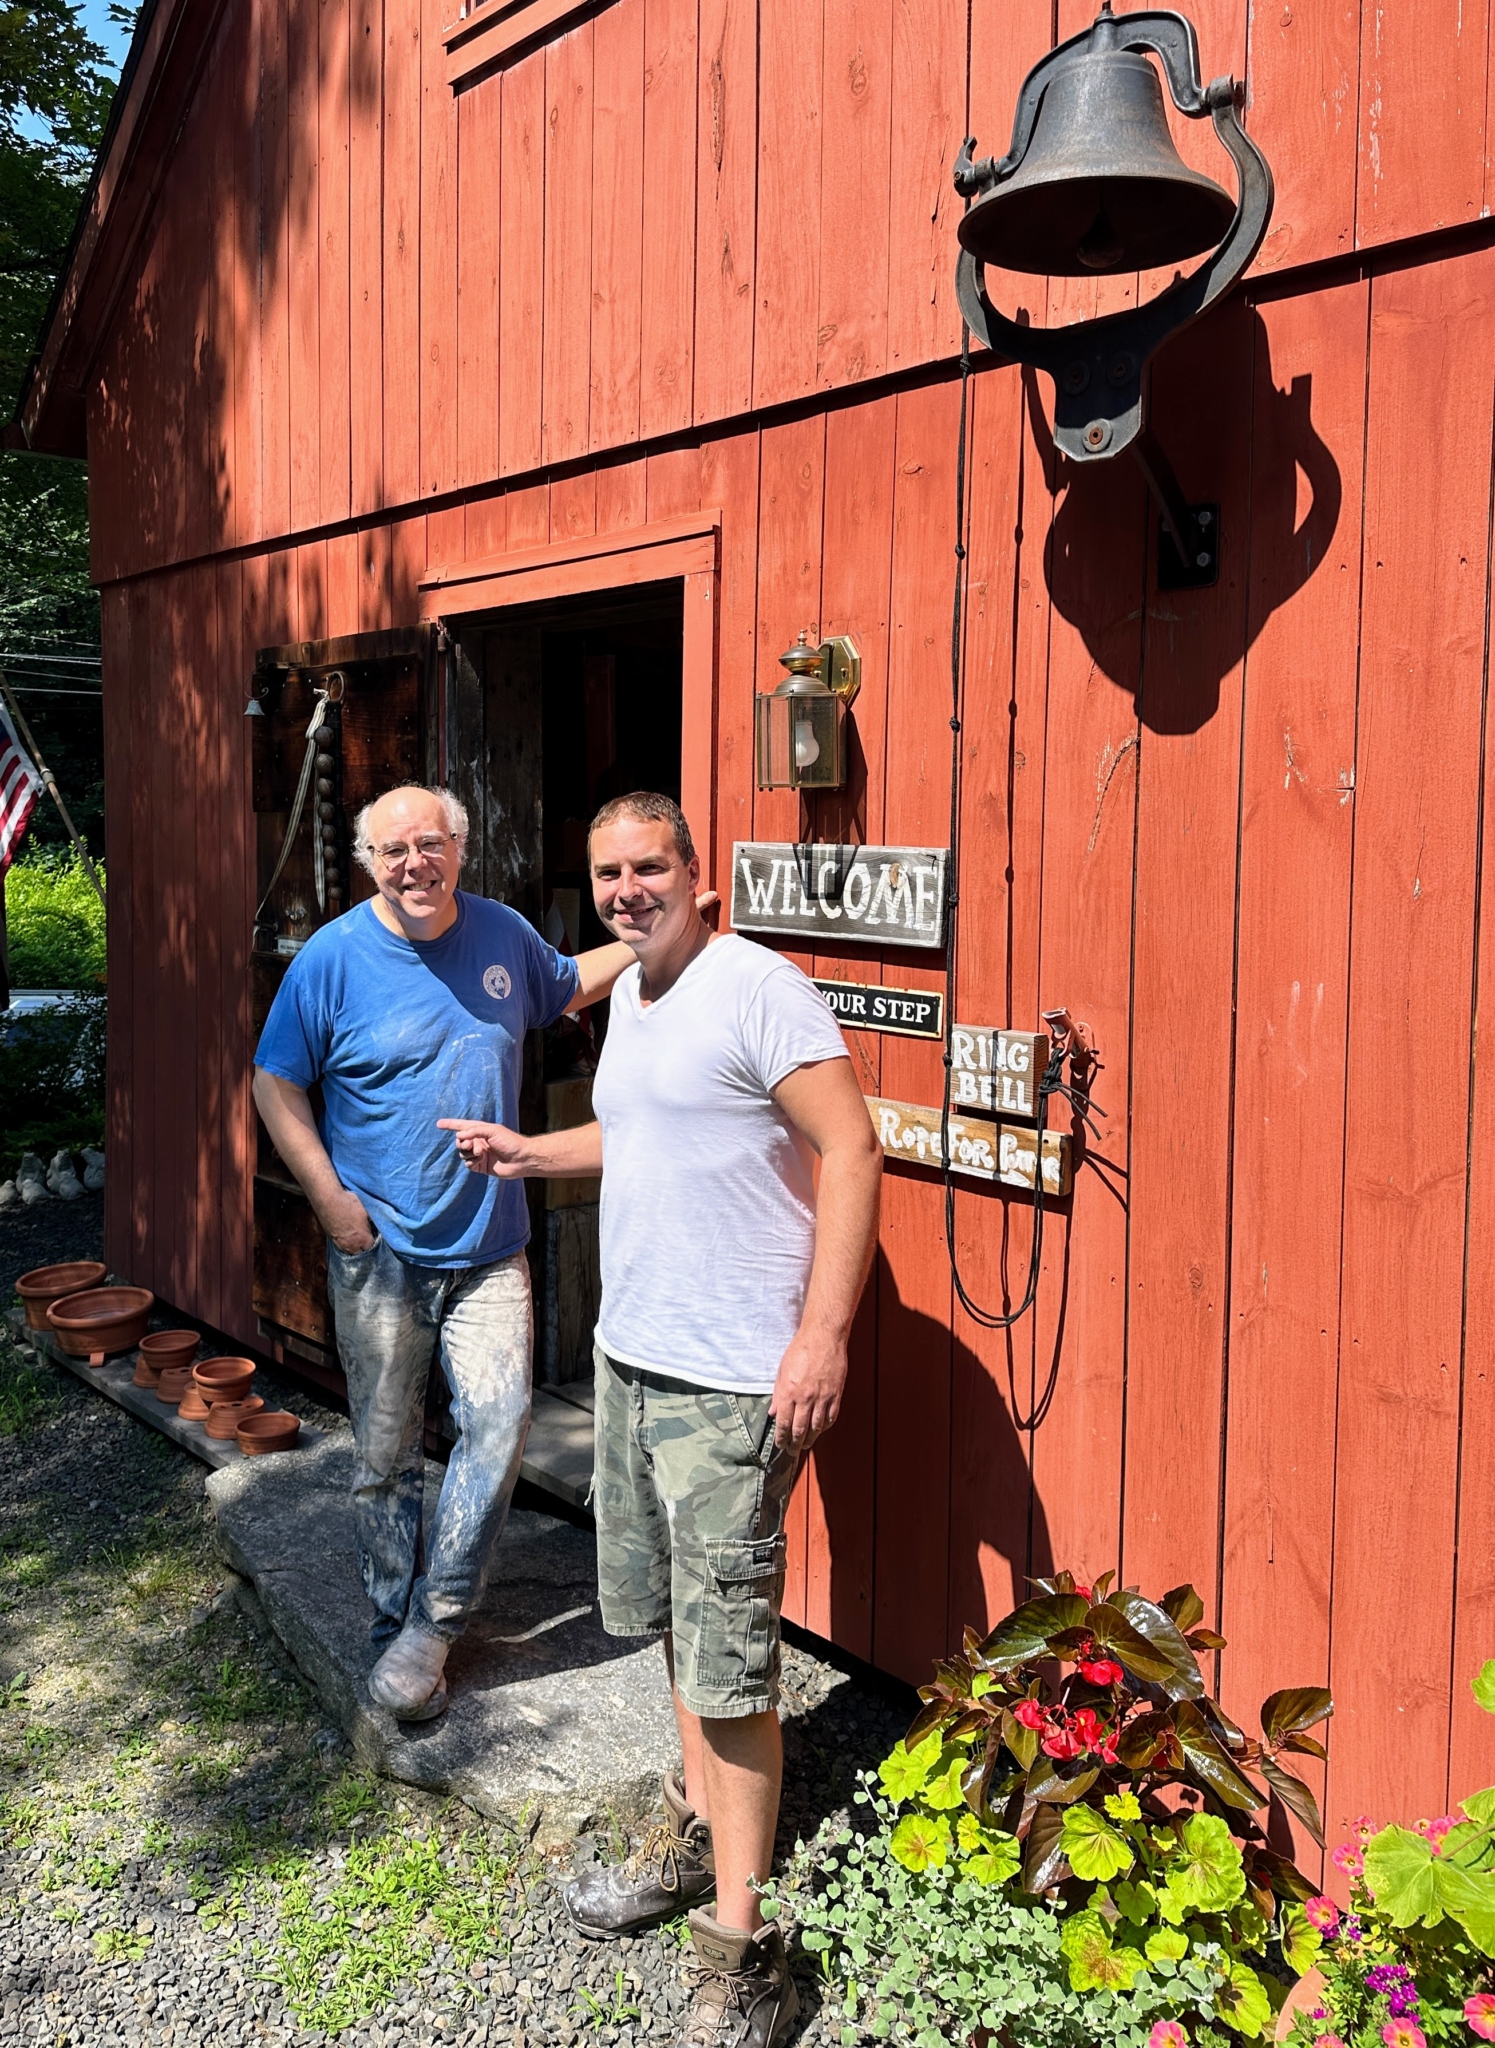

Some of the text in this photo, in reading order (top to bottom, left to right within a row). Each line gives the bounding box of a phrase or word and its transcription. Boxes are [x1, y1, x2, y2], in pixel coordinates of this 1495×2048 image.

[739, 858, 938, 931] WELCOME
[873, 997, 931, 1023] STEP
[952, 1031, 1029, 1072] RING
[954, 1071, 1032, 1113] BELL
